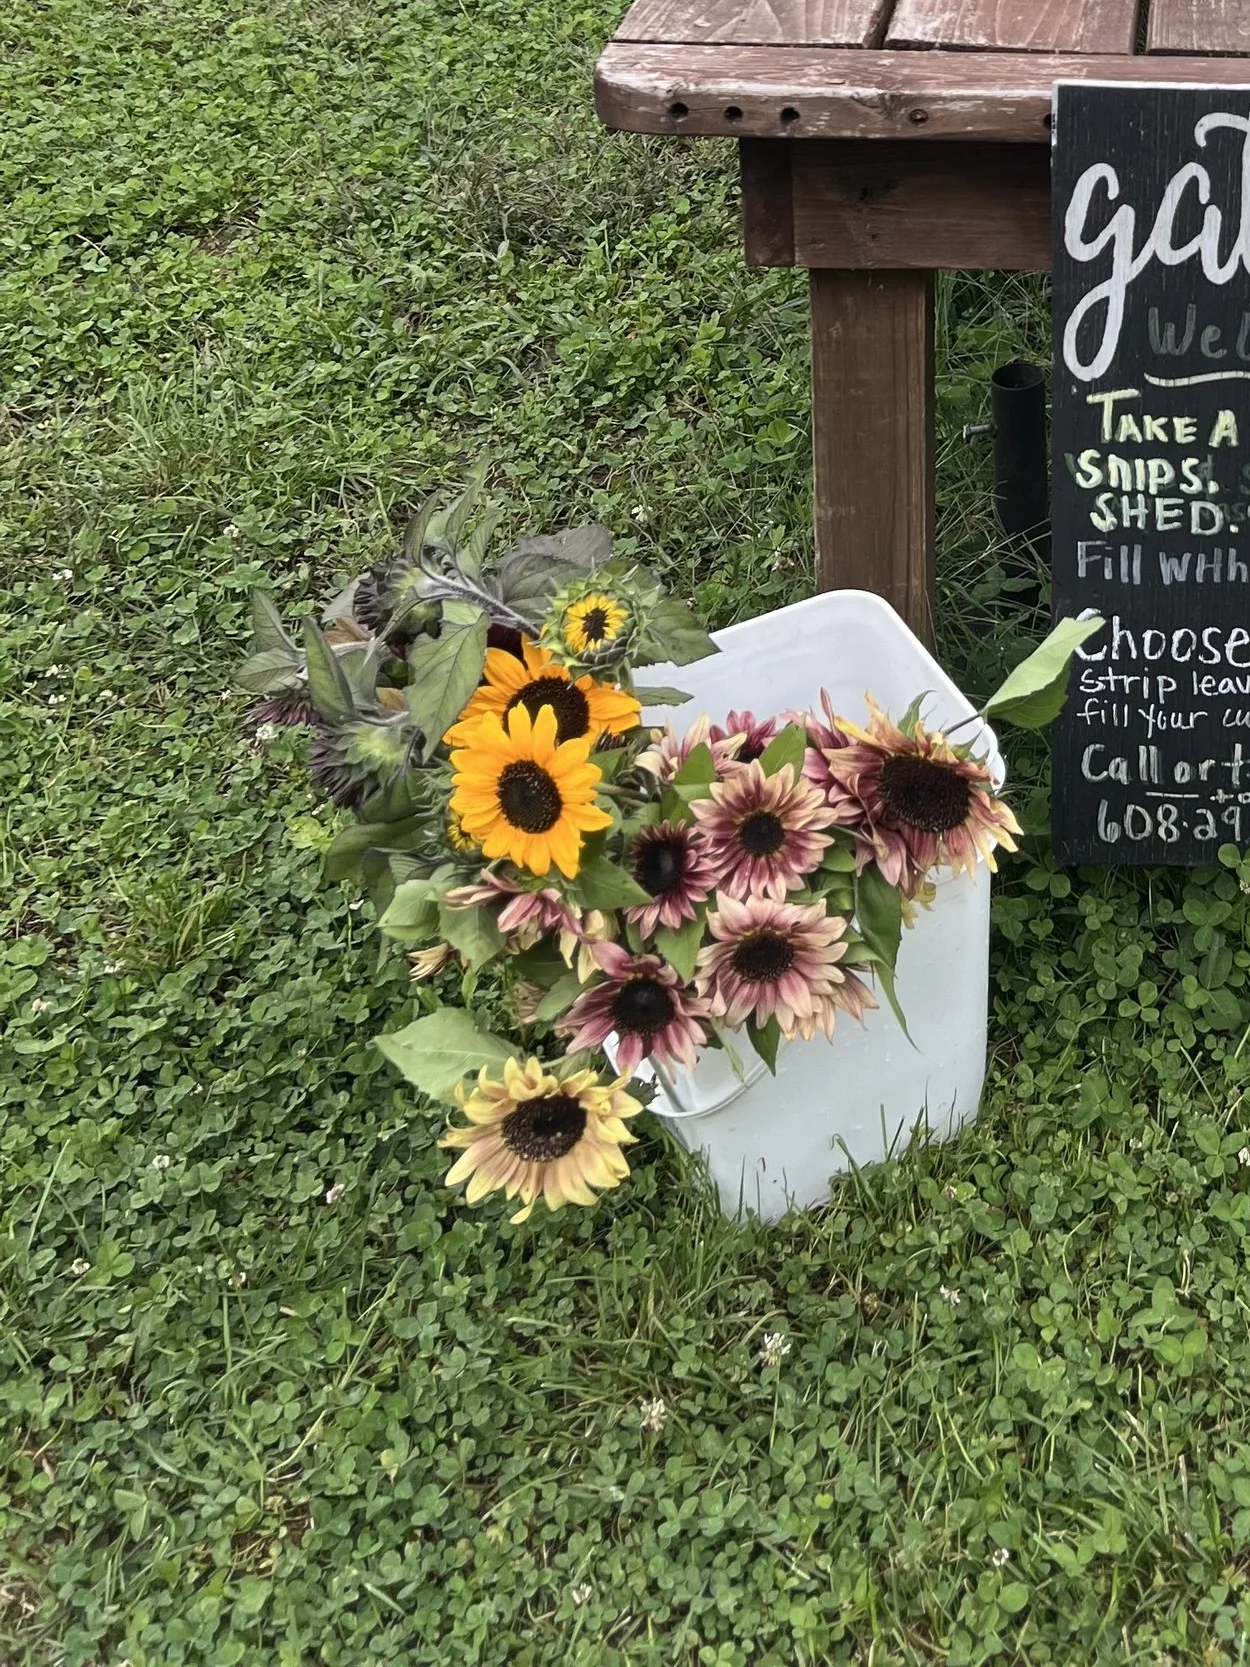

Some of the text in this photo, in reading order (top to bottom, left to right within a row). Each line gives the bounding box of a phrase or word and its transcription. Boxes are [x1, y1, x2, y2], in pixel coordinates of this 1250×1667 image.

[1208, 409, 1240, 449] A
[1089, 492, 1240, 536] SHED.
[1076, 540, 1142, 586] Fill
[1076, 698, 1130, 729] fill
[1138, 703, 1209, 740] your
[1081, 743, 1162, 785] Call
[1173, 758, 1216, 784] or
